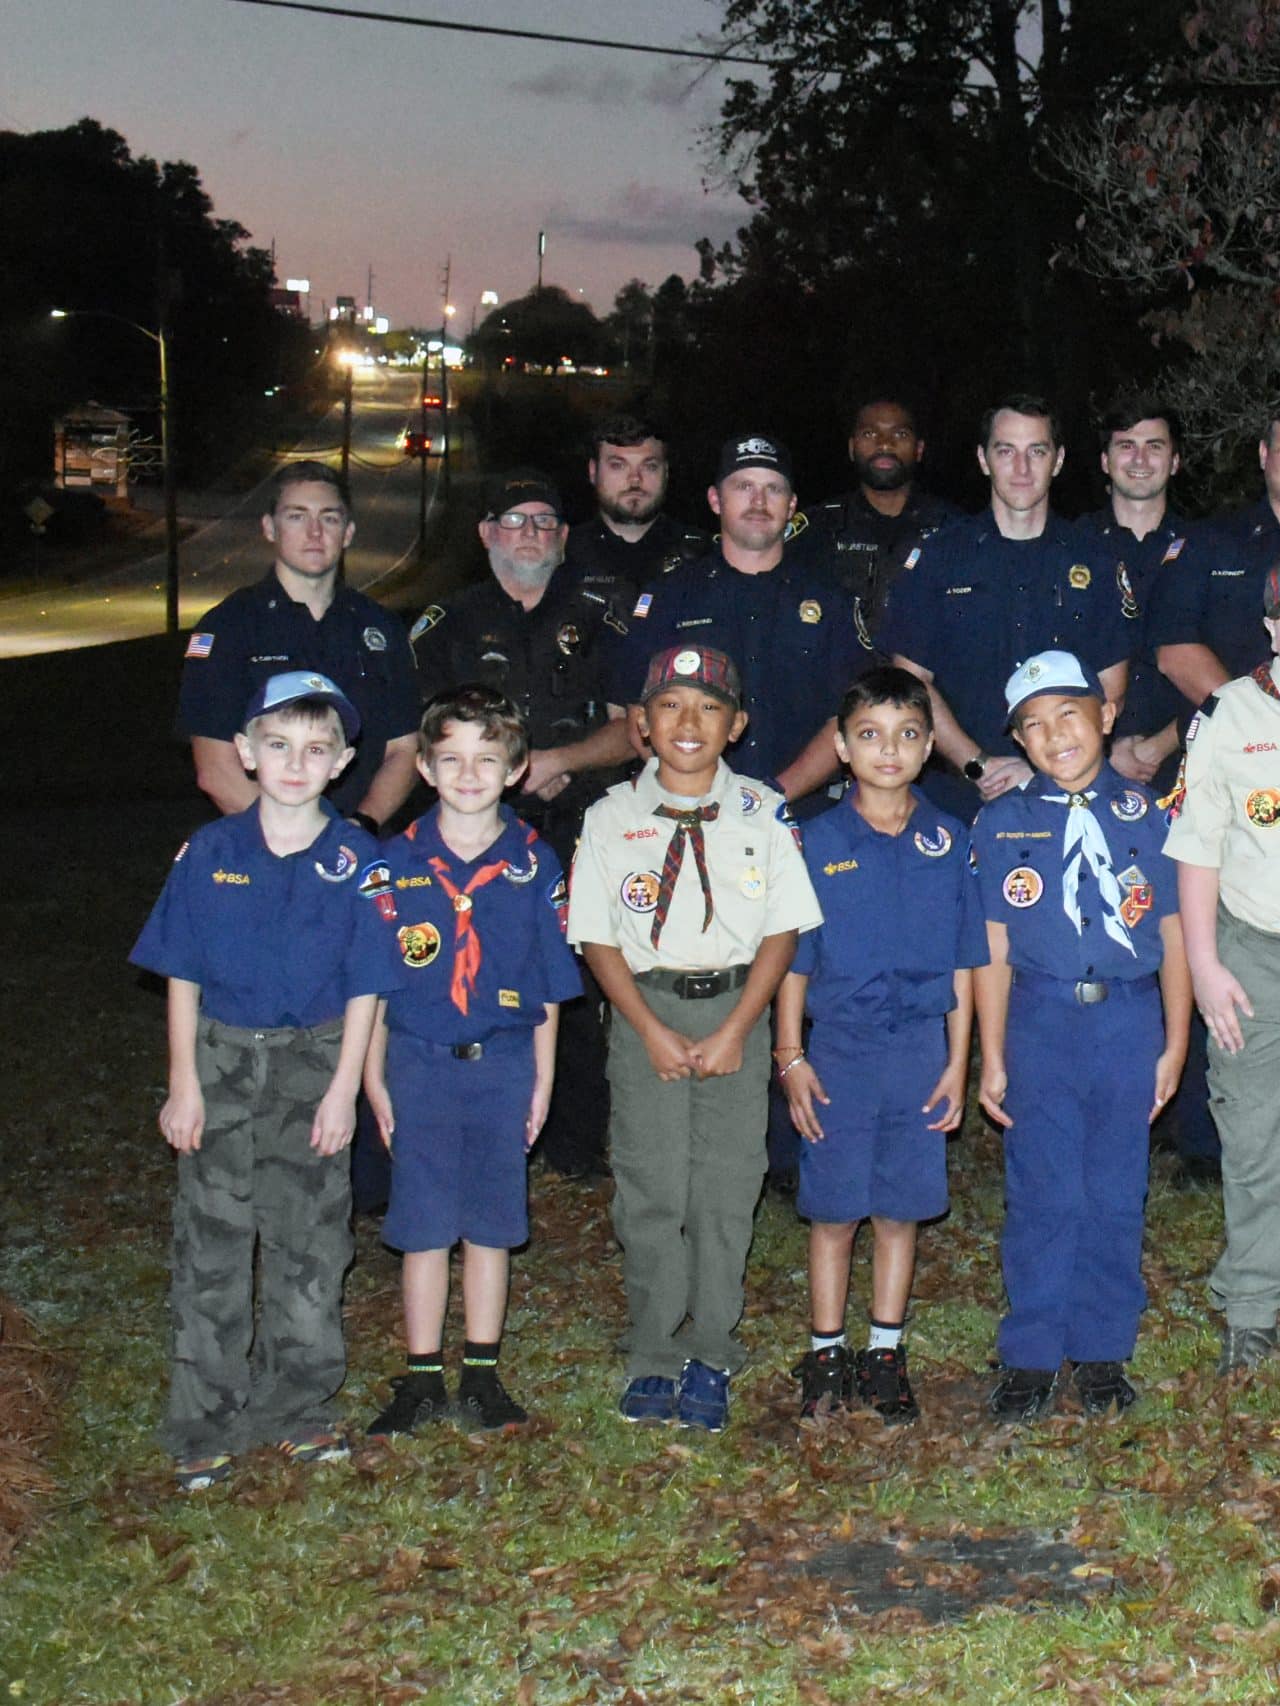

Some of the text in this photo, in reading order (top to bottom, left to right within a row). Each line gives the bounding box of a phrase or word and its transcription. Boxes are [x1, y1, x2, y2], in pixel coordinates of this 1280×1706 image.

[1256, 743, 1279, 753] BSA
[636, 828, 660, 840] BSA
[838, 859, 859, 872] BSA
[226, 873, 251, 886] BSA
[409, 876, 433, 888] BSA
